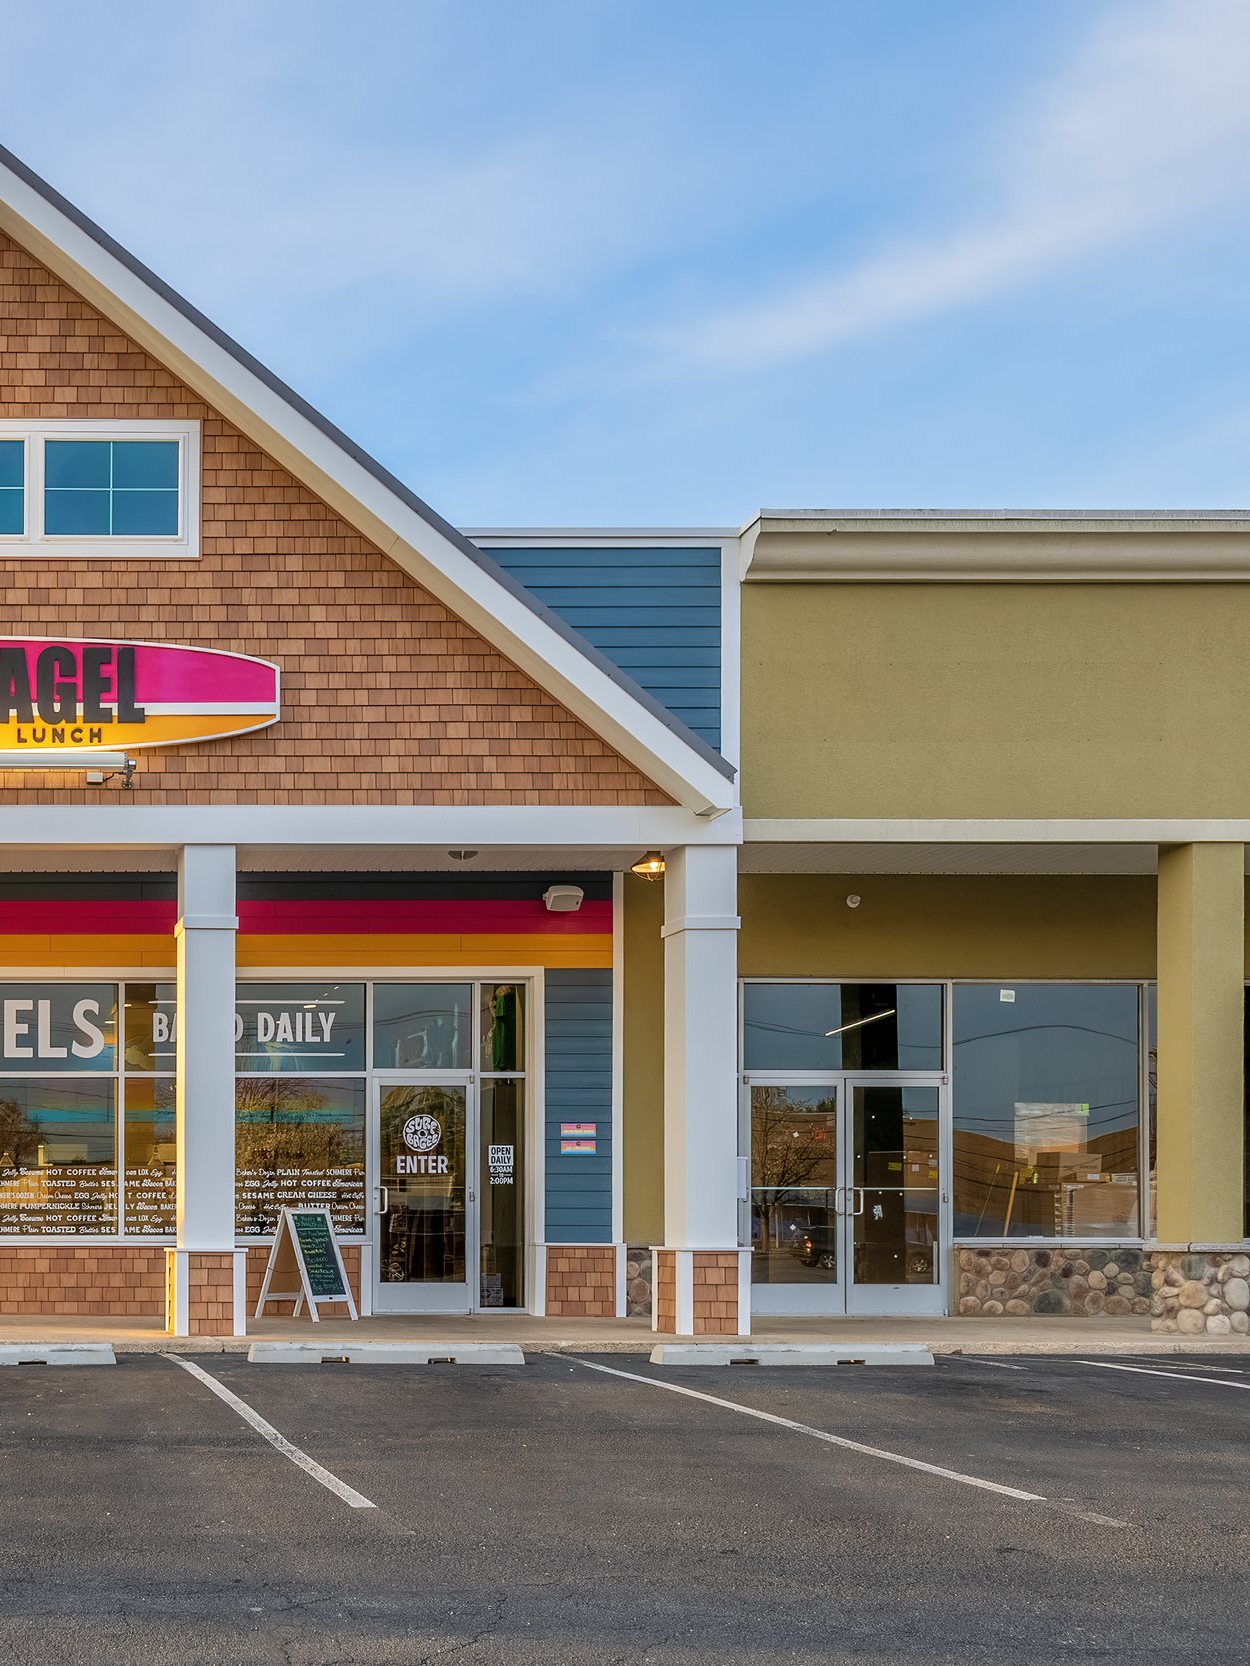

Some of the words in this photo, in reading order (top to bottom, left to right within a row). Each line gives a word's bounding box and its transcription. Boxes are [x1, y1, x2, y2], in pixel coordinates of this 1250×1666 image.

[17, 727, 104, 744] LUNCH
[257, 1012, 336, 1043] DAILY
[406, 1117, 438, 1134] SURF
[407, 1133, 438, 1150] BAGEL
[491, 1147, 511, 1155] OPEN
[396, 1156, 449, 1174] ENTER
[491, 1156, 511, 1165] DAILY
